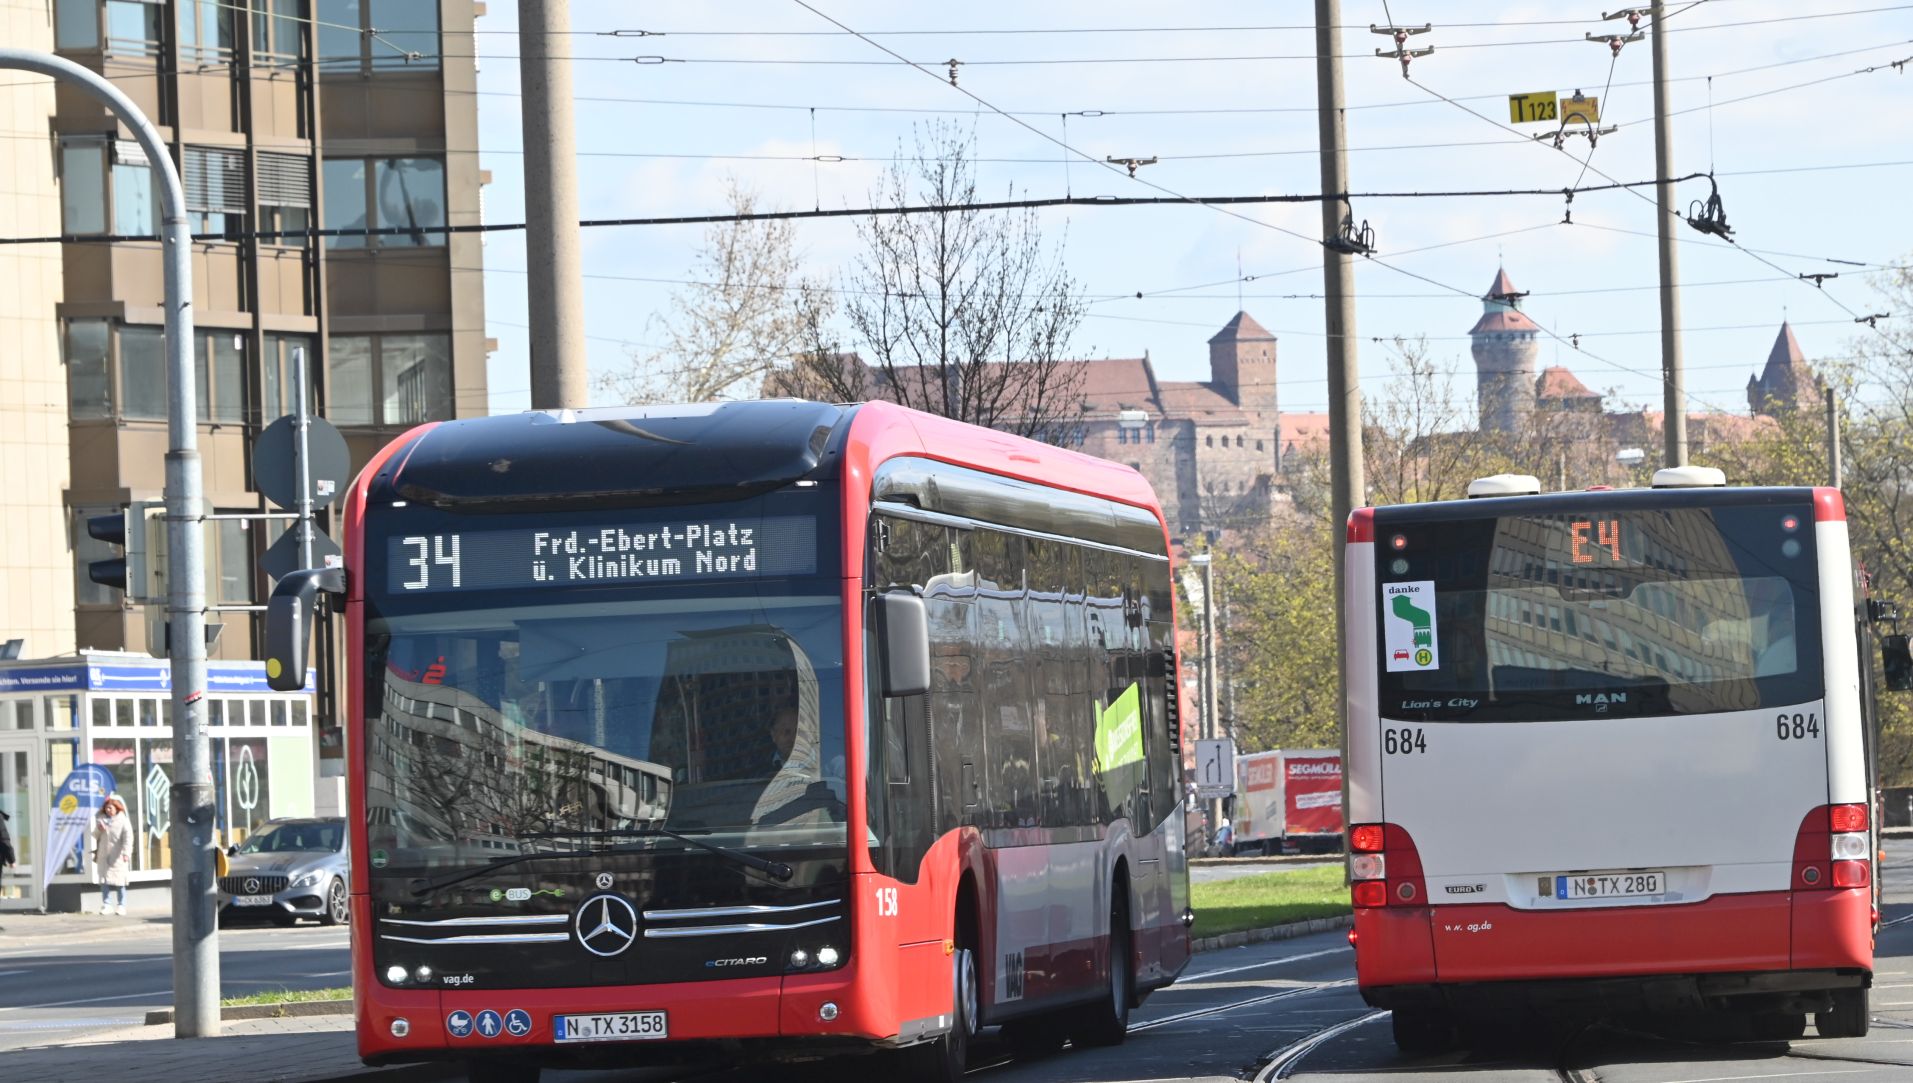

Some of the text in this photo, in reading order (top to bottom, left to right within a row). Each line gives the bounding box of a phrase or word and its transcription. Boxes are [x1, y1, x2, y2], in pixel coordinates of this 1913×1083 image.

[1510, 96, 1556, 122] T 123
[534, 523, 753, 556] Frd.-Ebert-Platz
[1571, 520, 1620, 563] E4
[402, 534, 461, 589] 34
[533, 548, 756, 582] ü. Klinikum Nord
[1388, 585, 1421, 595] danke
[1401, 697, 1479, 710] Lion's City
[1575, 692, 1627, 704] MAN
[1776, 713, 1820, 741] 684
[1384, 727, 1427, 755] 684
[69, 779, 99, 792] GLS
[508, 889, 529, 899] BUS
[1574, 878, 1586, 896] N
[1598, 877, 1620, 894] TX
[1624, 875, 1657, 894] 280
[876, 887, 898, 916] 158
[443, 973, 474, 986] vag.de
[567, 1018, 579, 1036] N
[591, 1017, 614, 1035] TX
[618, 1015, 663, 1034] 3158
